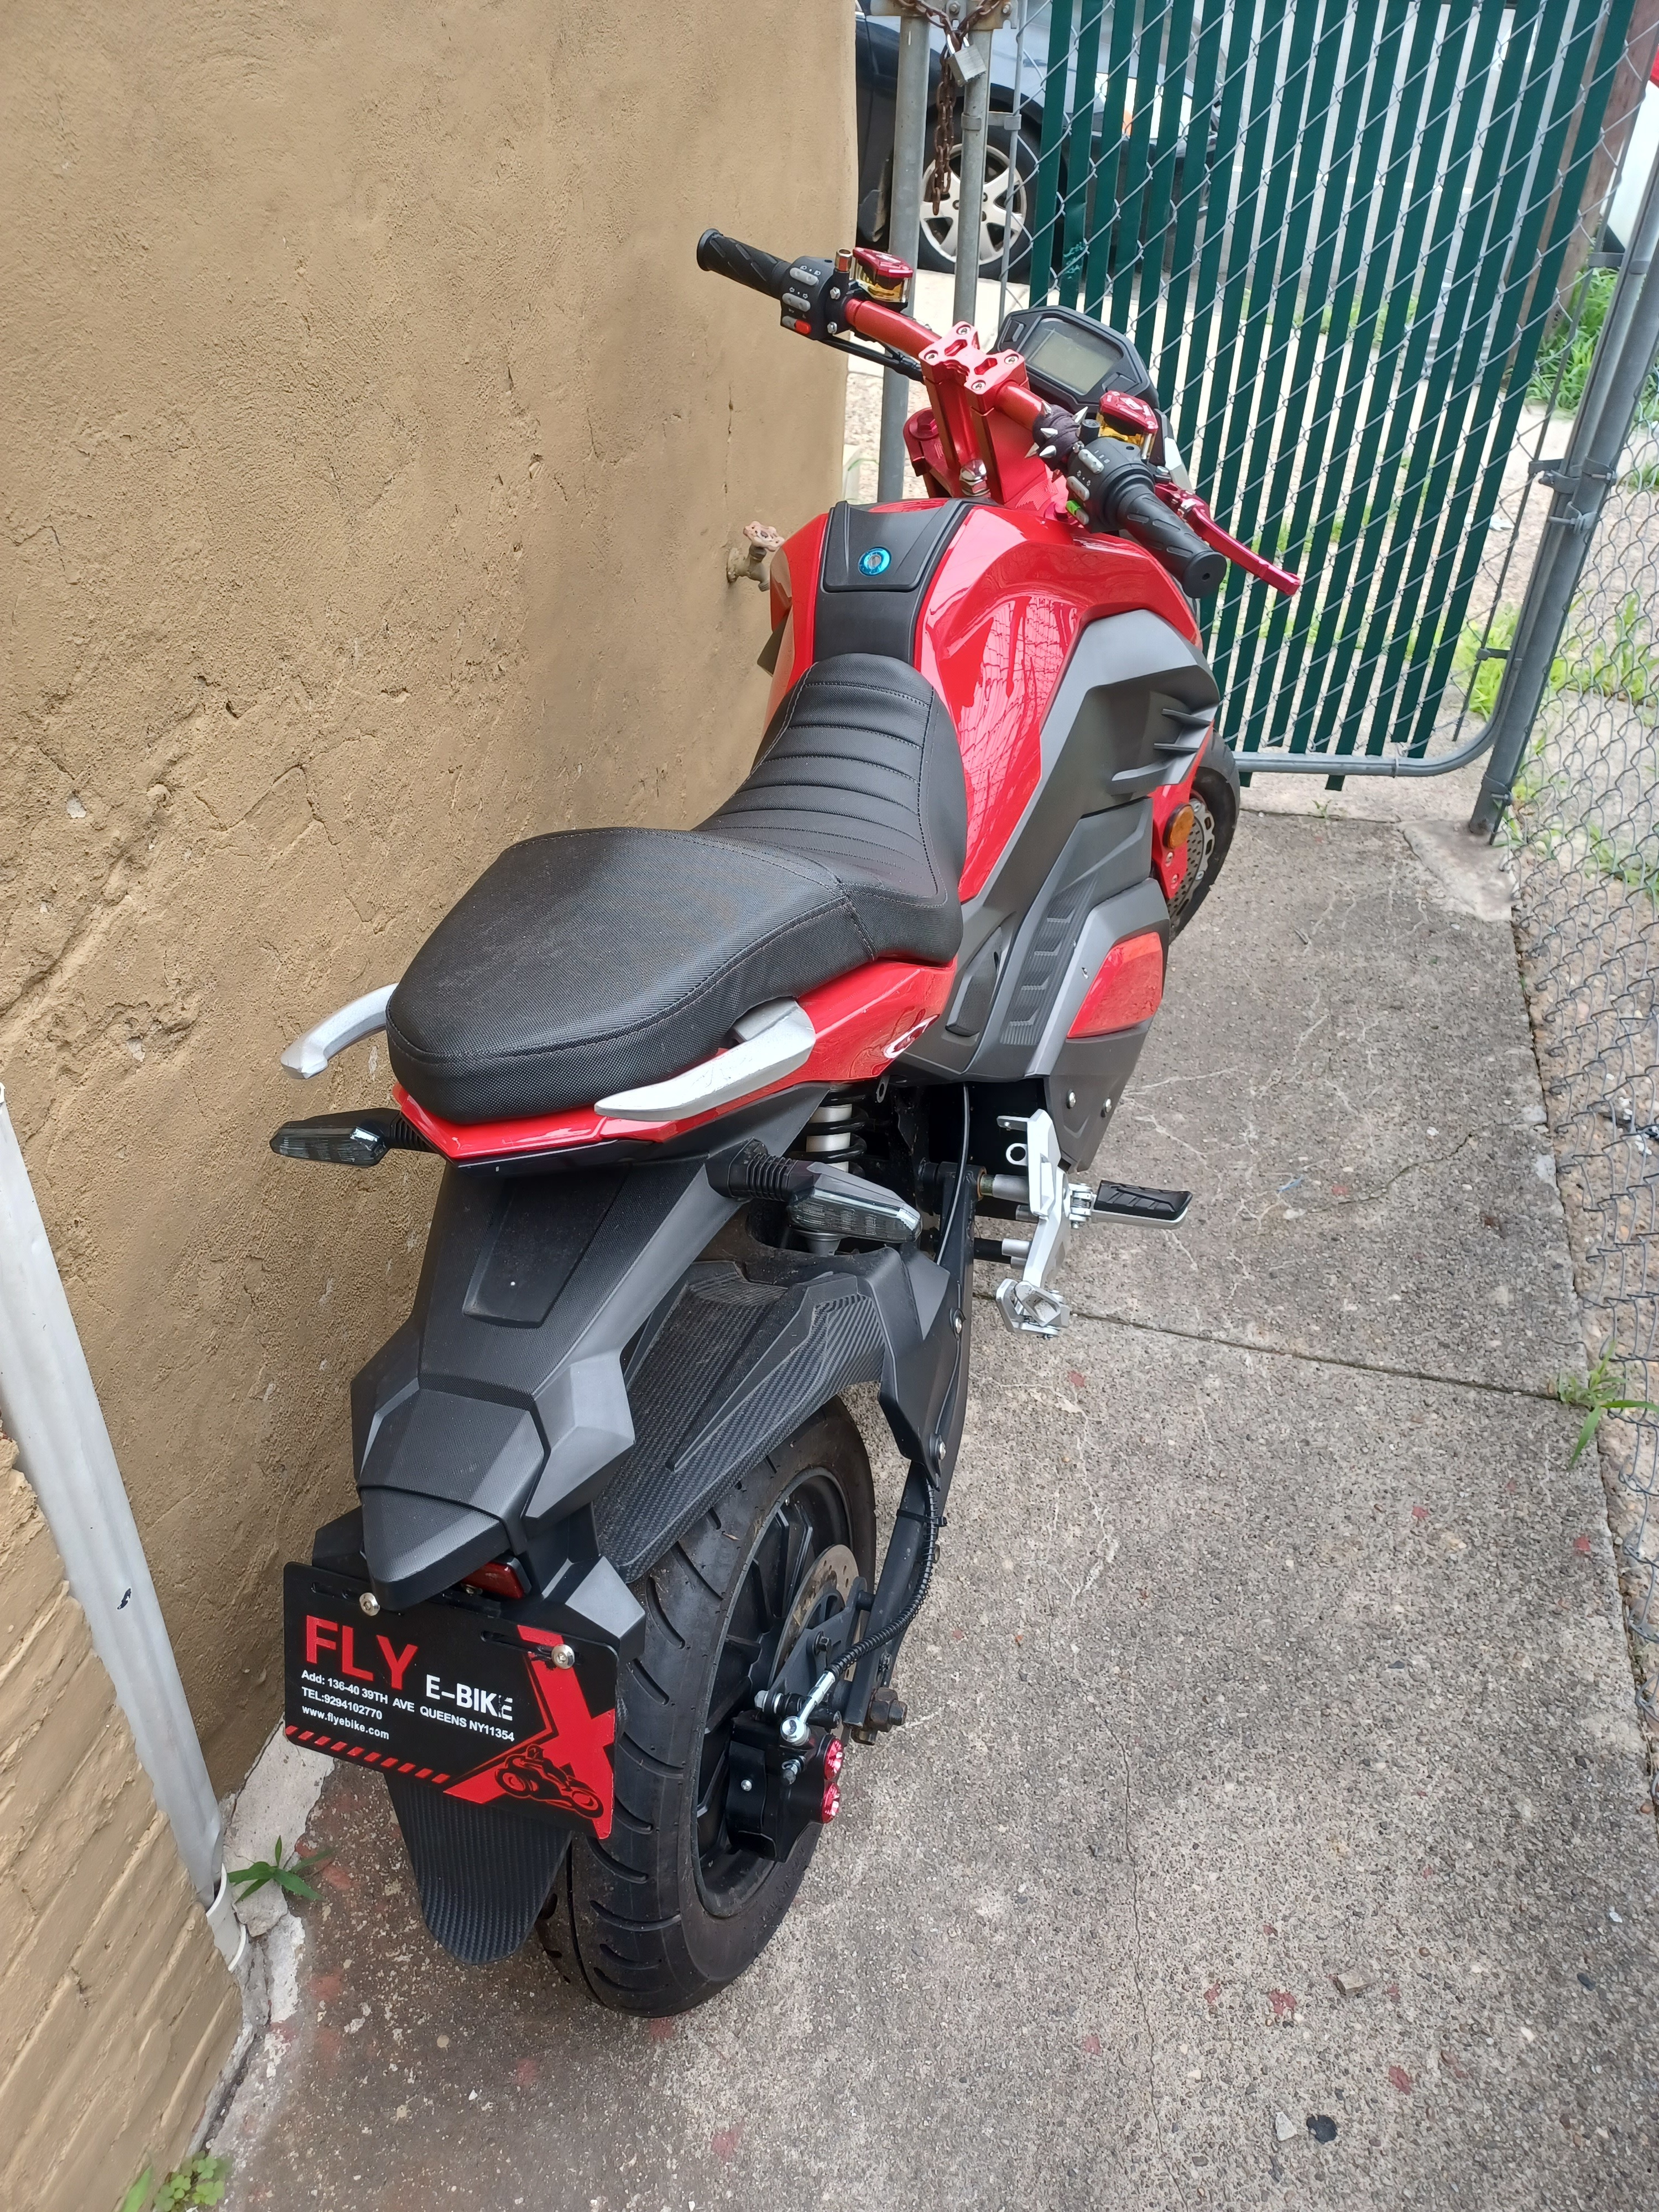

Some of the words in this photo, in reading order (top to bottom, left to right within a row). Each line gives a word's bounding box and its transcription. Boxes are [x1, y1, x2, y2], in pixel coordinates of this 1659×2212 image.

[306, 1615, 418, 1690] FLY
[426, 1674, 513, 1721] E-BIKE
[301, 1686, 383, 1720] TEL:9294102770
[301, 1670, 325, 1685] Add:
[327, 1678, 359, 1695] 136-40
[361, 1688, 388, 1704] 39TH
[392, 1698, 415, 1713] AVE
[420, 1706, 467, 1728] QUEENS
[469, 1720, 515, 1742] NY11354
[301, 1705, 389, 1740] www.flyebike.com
